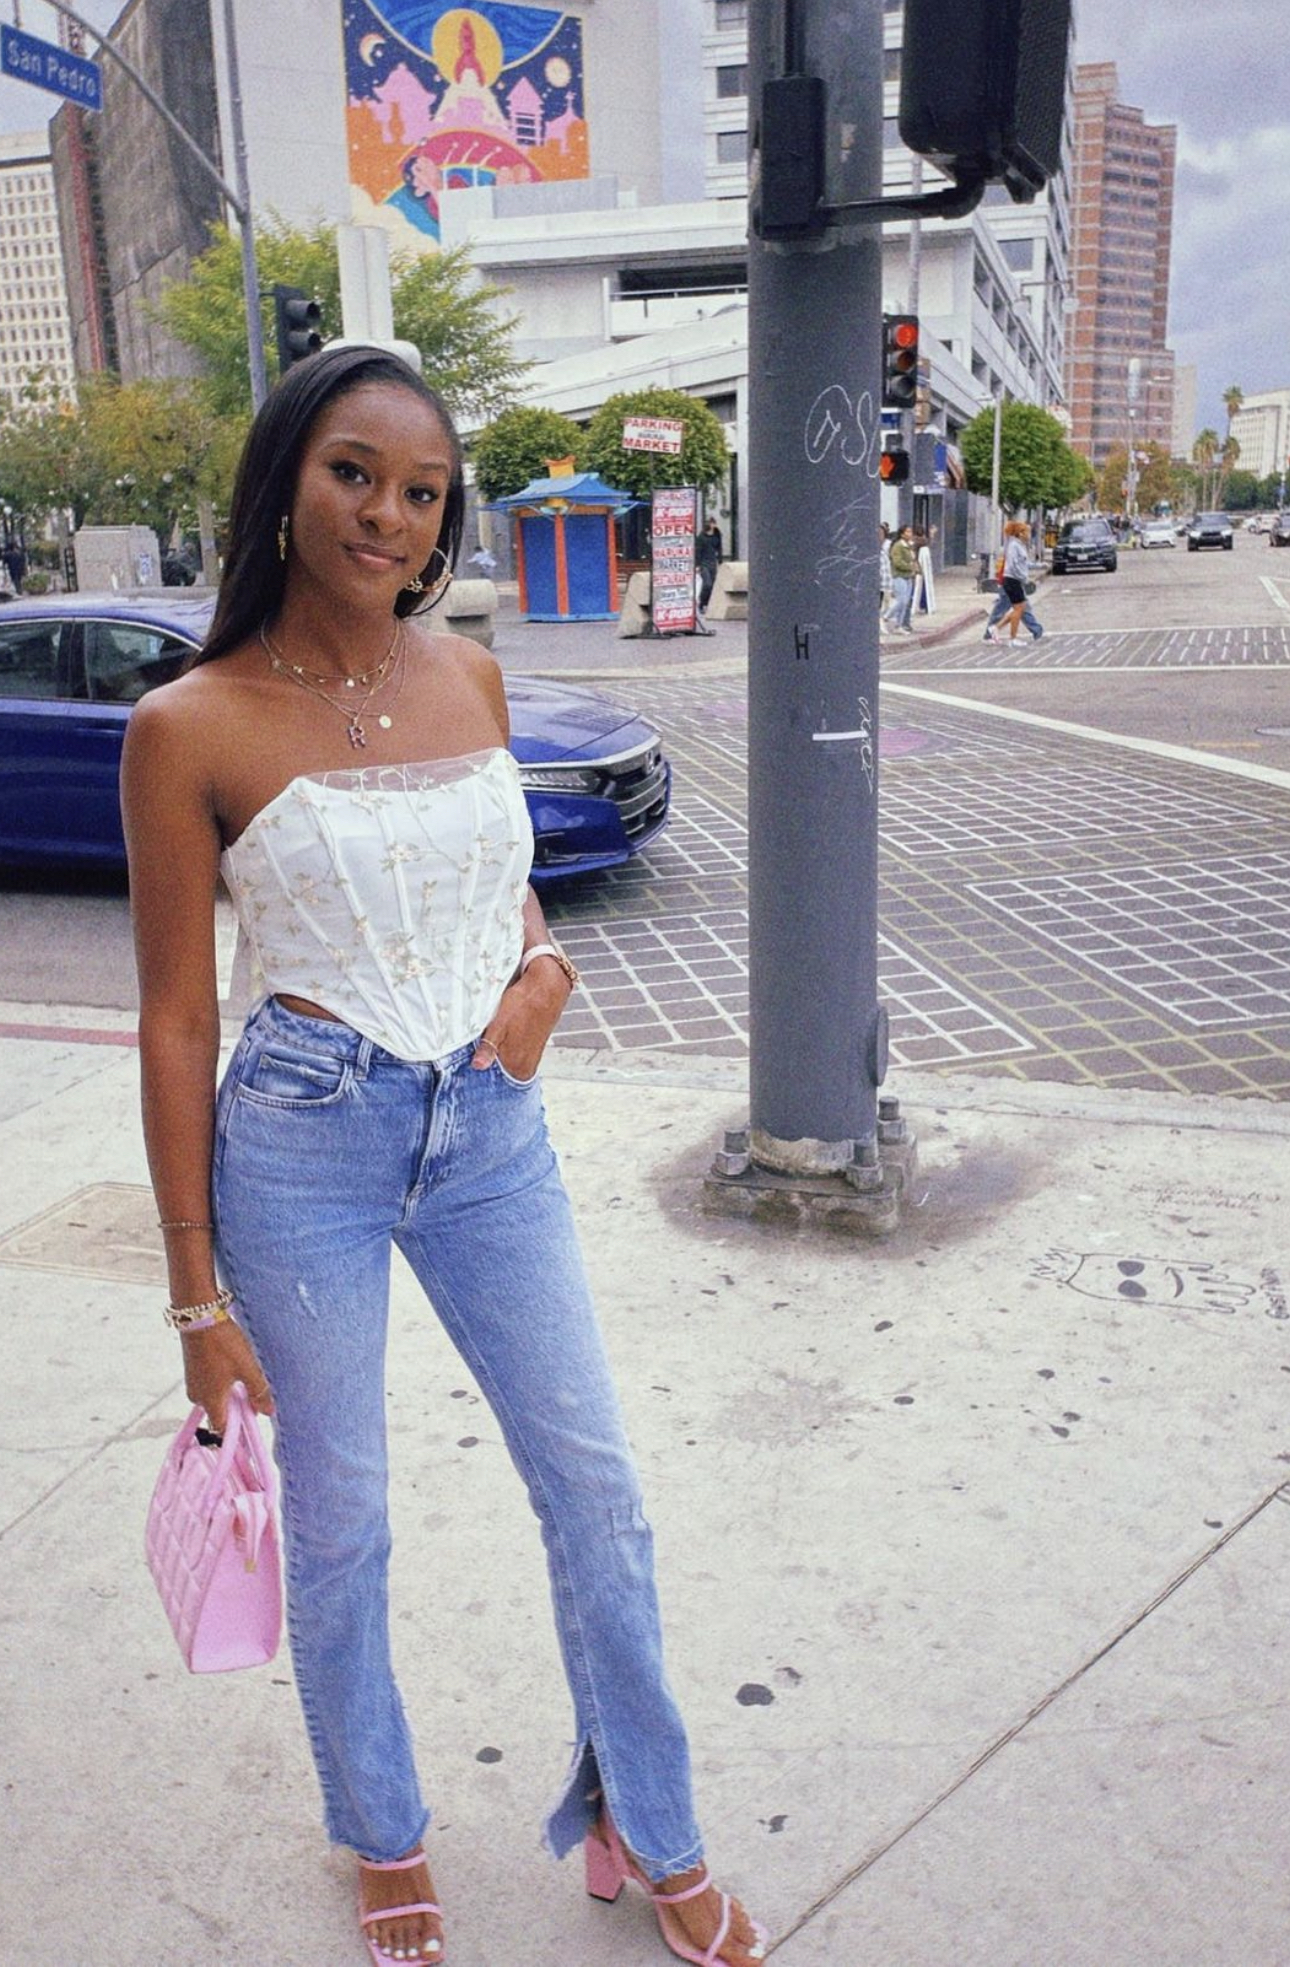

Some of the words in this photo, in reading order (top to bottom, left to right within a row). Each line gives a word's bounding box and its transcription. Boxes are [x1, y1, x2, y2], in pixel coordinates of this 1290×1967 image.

[7, 40, 42, 77] San
[47, 55, 97, 98] Pedro
[623, 418, 682, 431] PARKING
[624, 438, 681, 452] MARKET
[653, 525, 693, 536] OPEN
[794, 624, 809, 660] H
